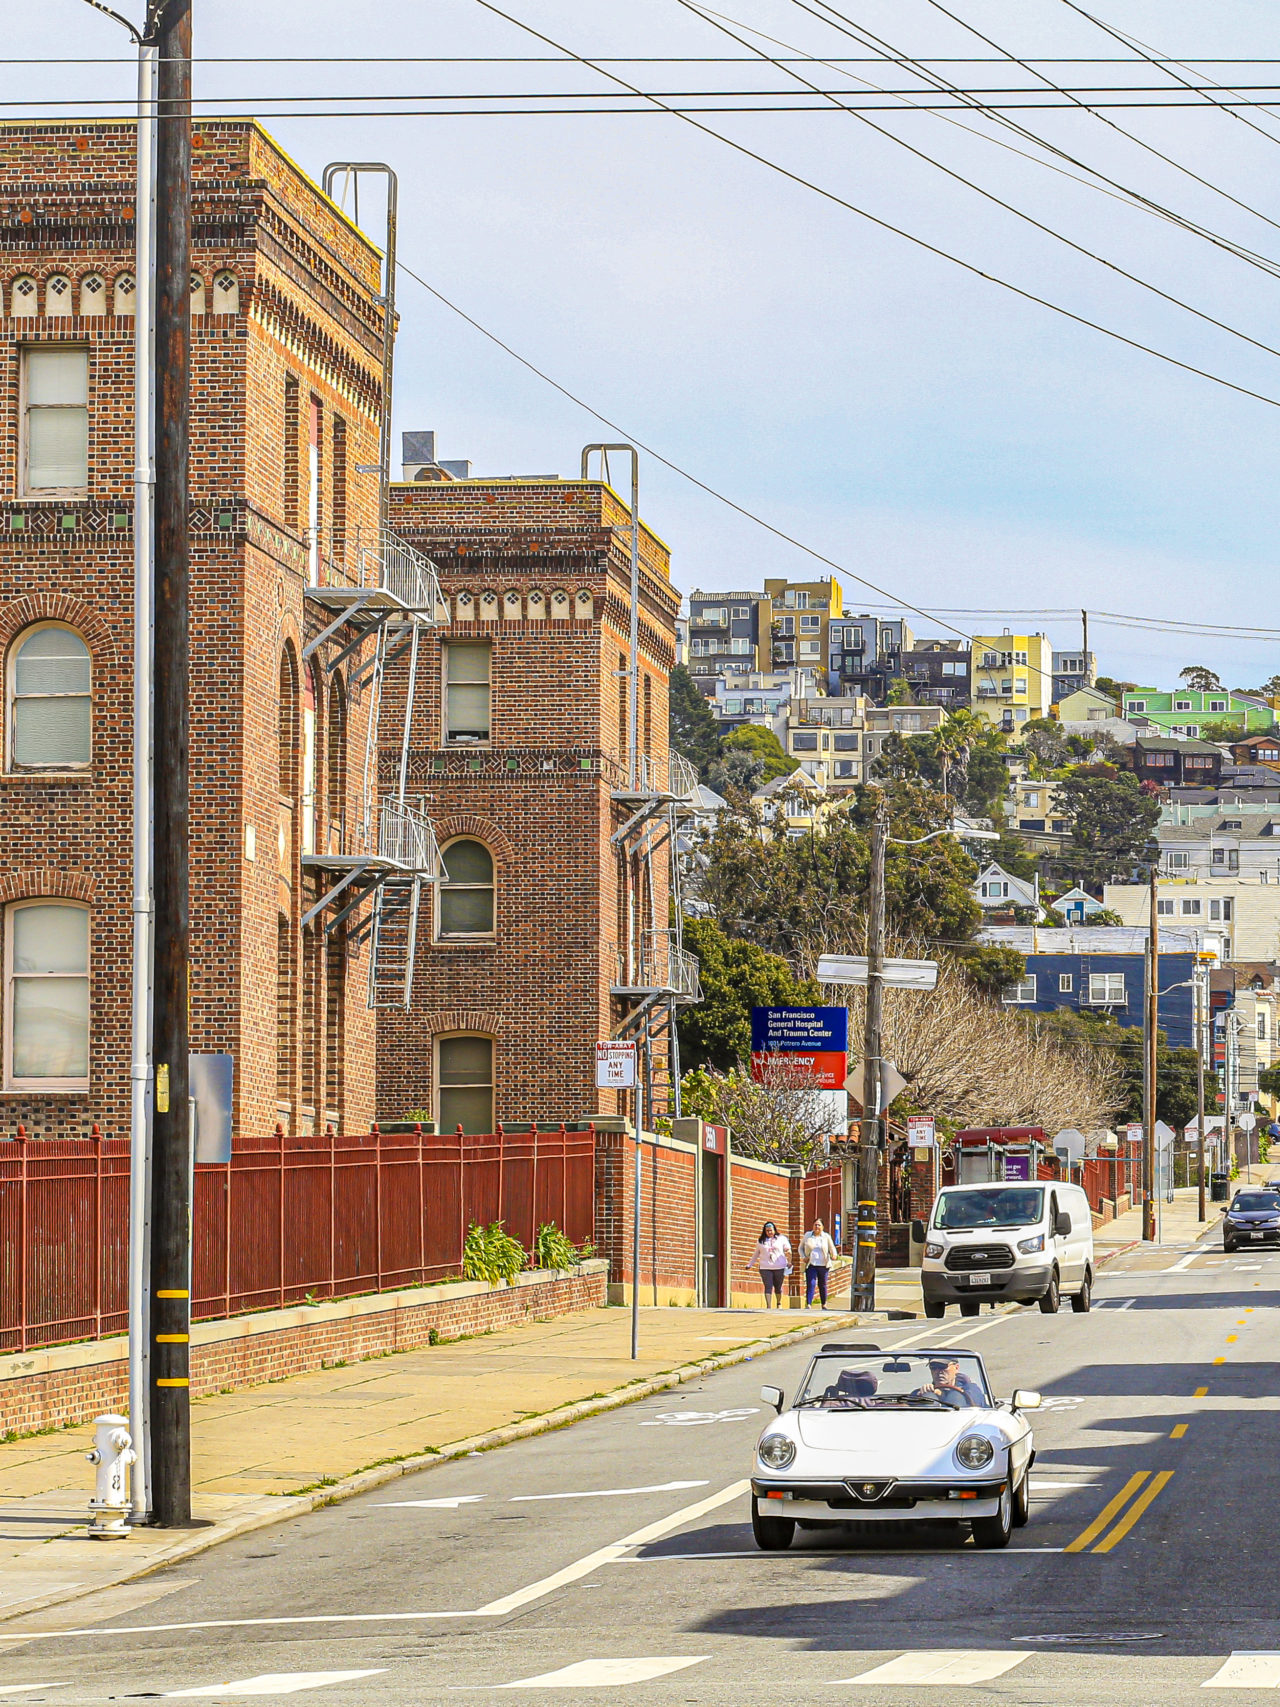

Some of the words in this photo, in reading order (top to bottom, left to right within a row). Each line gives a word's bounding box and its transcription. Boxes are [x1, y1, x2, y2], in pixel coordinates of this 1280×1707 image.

[768, 1020, 794, 1028] General
[795, 1020, 823, 1029] Hospital
[597, 1050, 608, 1060] NO
[608, 1051, 634, 1060] STOPPING
[607, 1070, 625, 1078] TIME
